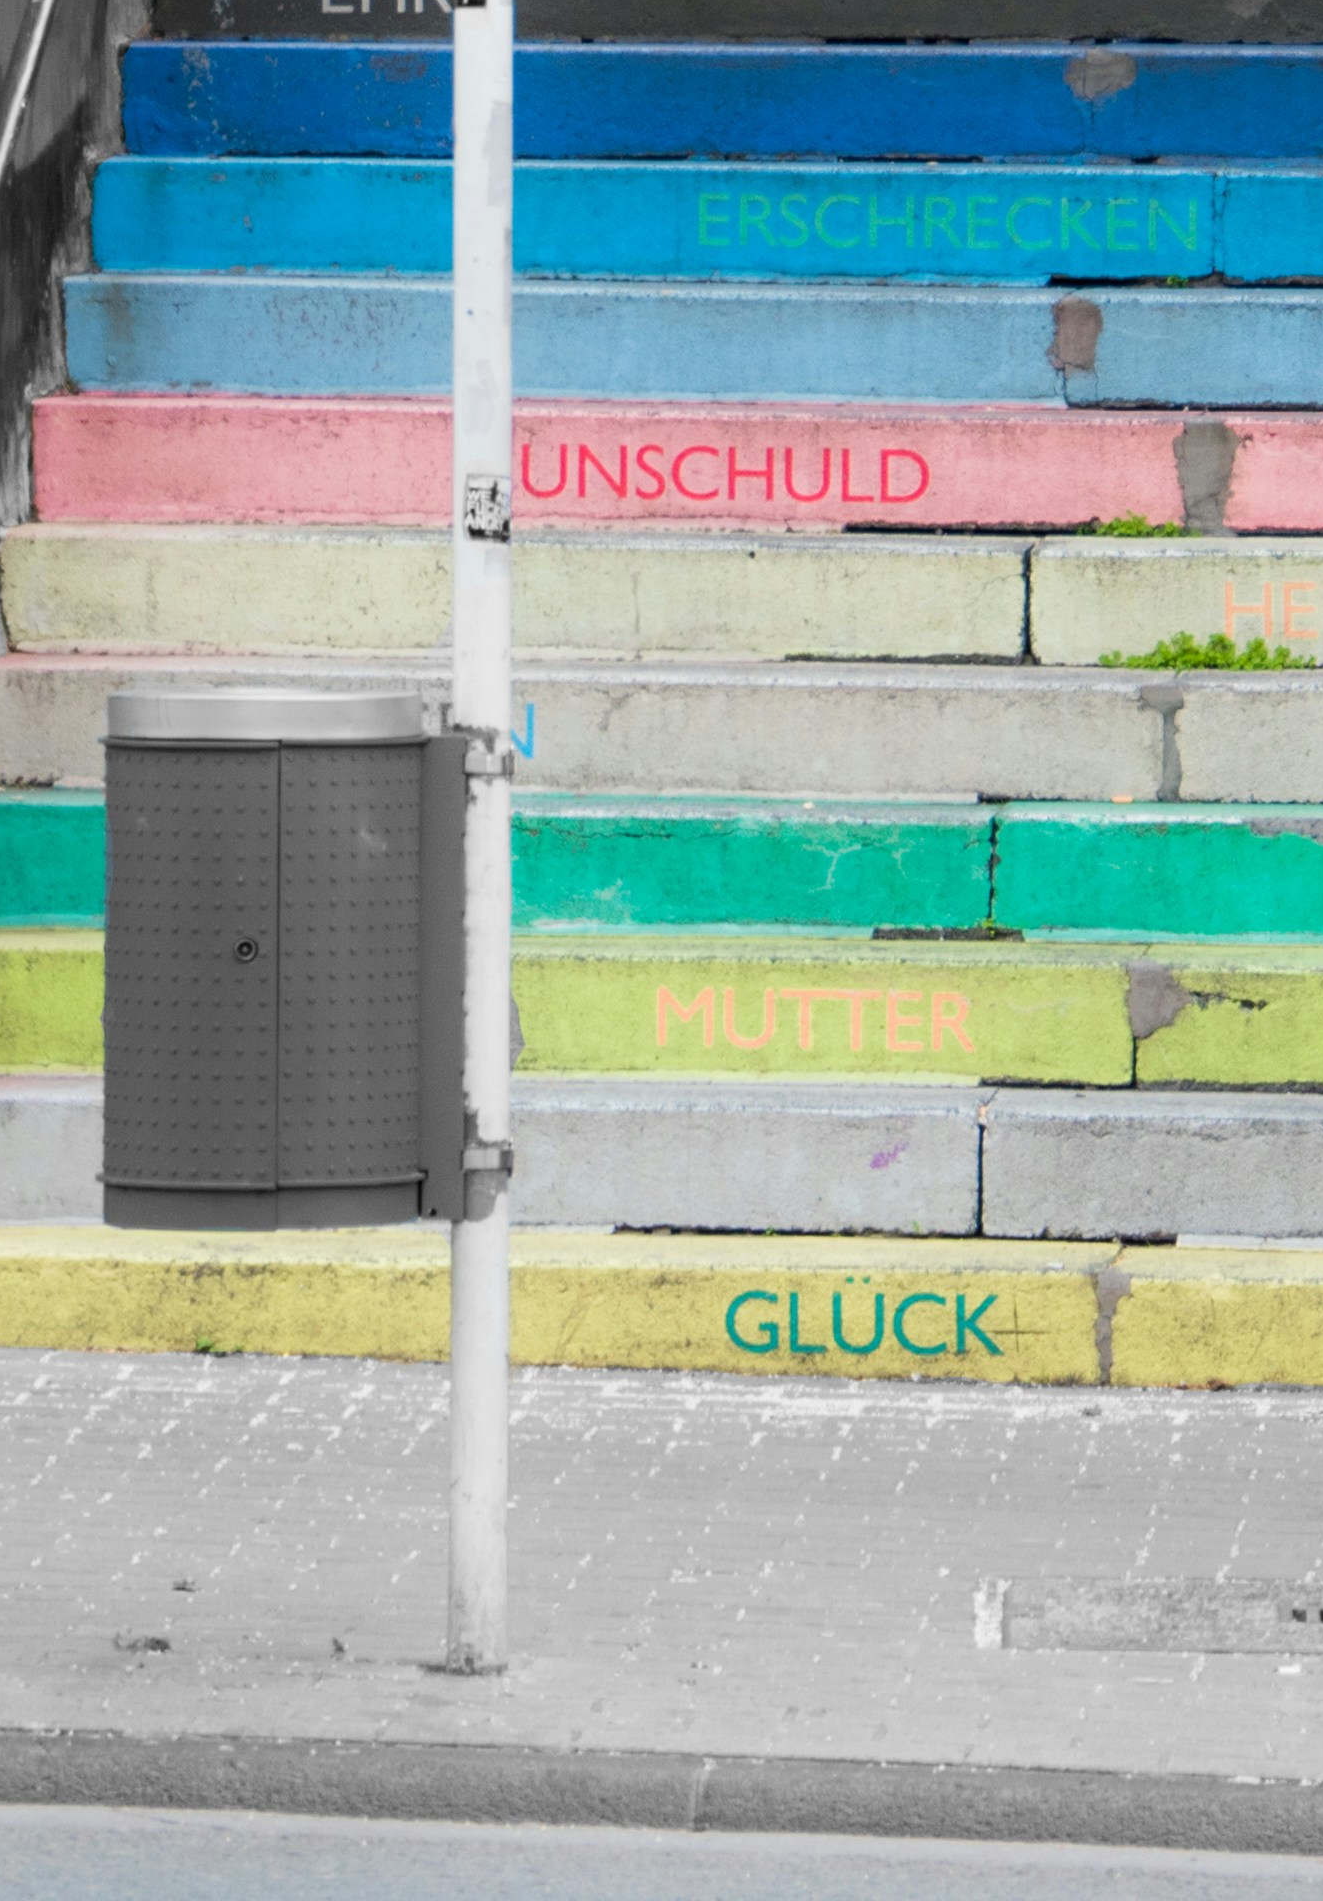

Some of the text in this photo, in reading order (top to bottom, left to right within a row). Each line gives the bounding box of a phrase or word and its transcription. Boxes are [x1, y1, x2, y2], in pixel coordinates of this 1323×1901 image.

[698, 193, 1199, 253] ERSCHRECKEN
[520, 442, 930, 504] UNSCHULD
[656, 985, 976, 1053] MUTTER
[727, 1276, 1006, 1359] GLÜCK
